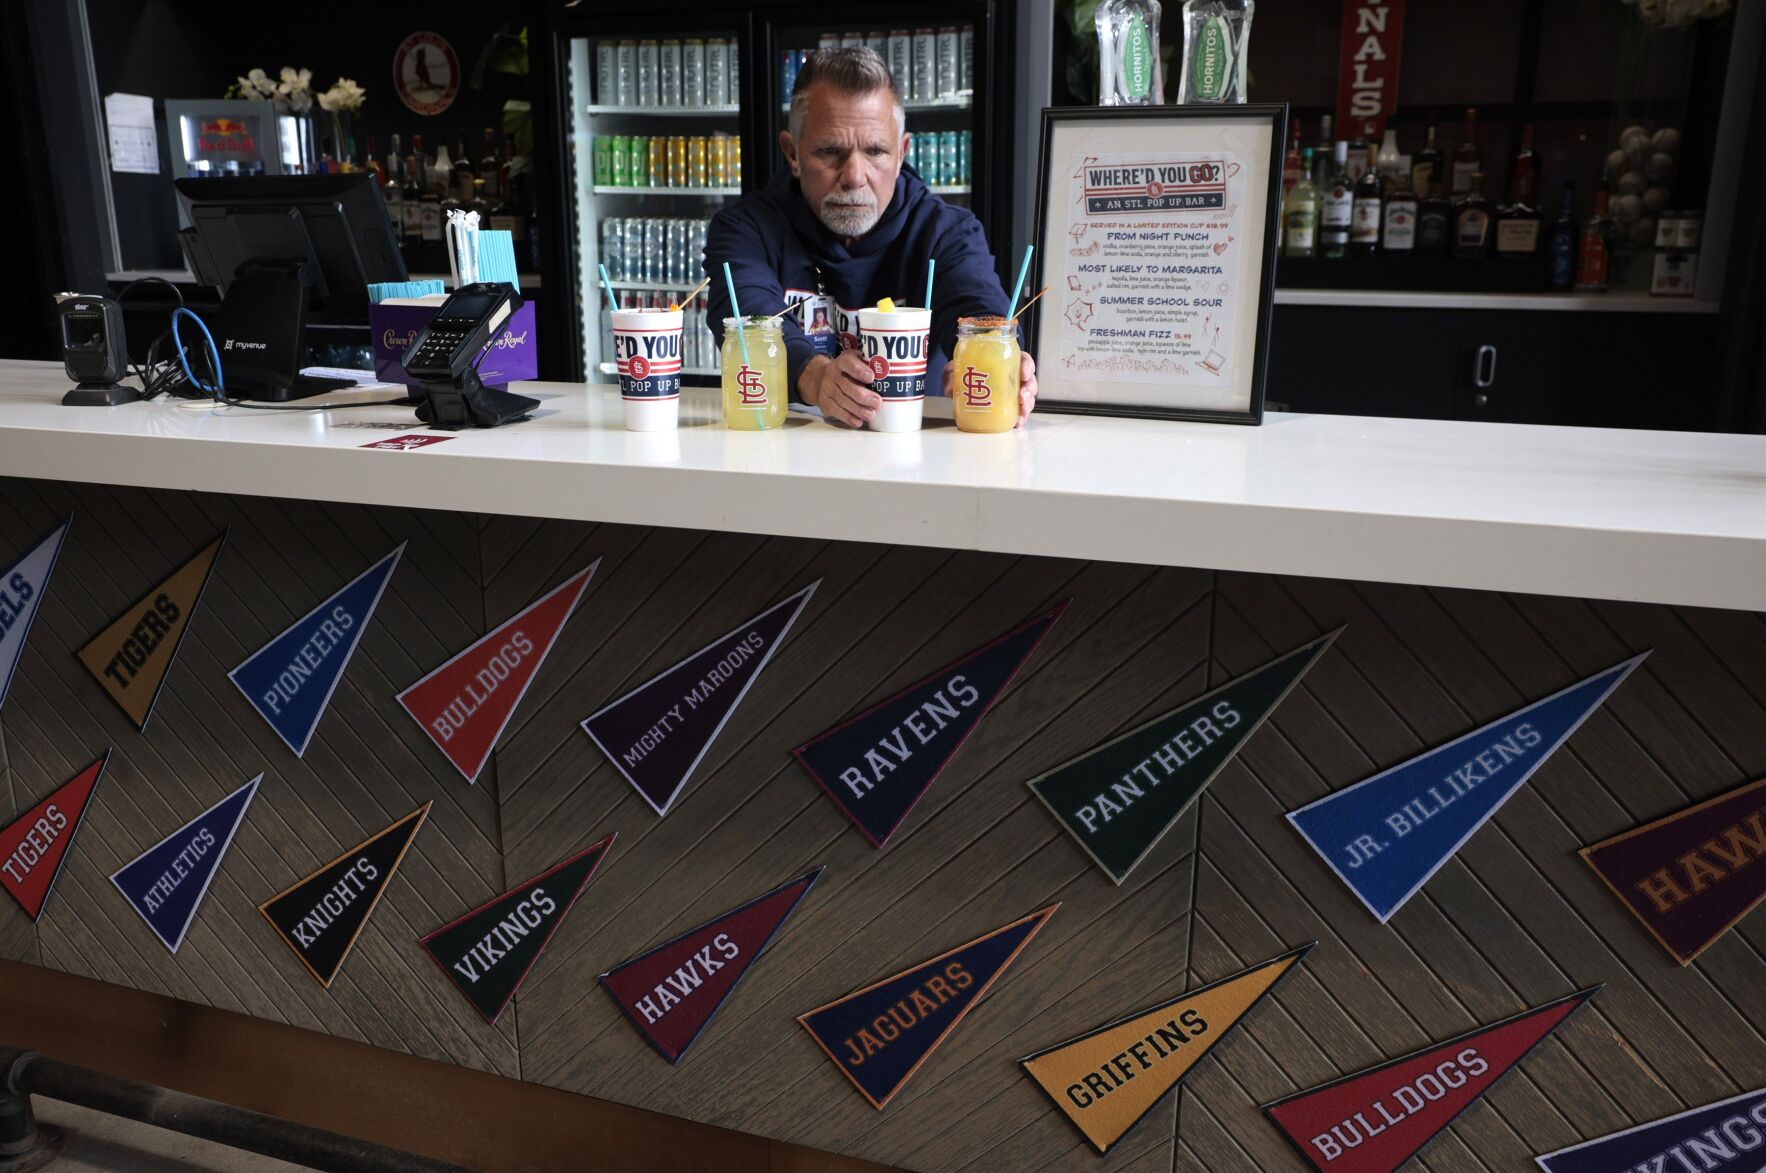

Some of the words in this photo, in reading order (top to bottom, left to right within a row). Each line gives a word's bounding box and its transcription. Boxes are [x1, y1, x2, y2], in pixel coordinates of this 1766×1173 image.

[1133, 28, 1143, 93] HORNITOS
[1203, 28, 1217, 94] HORNITOS
[1090, 167, 1155, 187] WHERE'D
[1158, 165, 1187, 184] YOU
[1189, 164, 1220, 184] GO?
[1107, 200, 1121, 209] AN
[1124, 199, 1143, 208] STL
[1147, 198, 1164, 207] POP
[1169, 198, 1182, 206] UP
[1186, 196, 1205, 206] BAR
[1078, 264, 1106, 273] MOST
[1110, 265, 1142, 273] LIKELY
[1146, 266, 1159, 274] TO
[1162, 266, 1223, 274] MARGARITA
[1174, 232, 1209, 240] PUNCH
[384, 329, 408, 350] Crown
[499, 331, 527, 349] Royal
[1090, 328, 1146, 338] FRESHMAN
[1148, 330, 1172, 338] FIZZ
[1100, 296, 1144, 306] SUMMER
[1146, 298, 1190, 306] SCHOOL
[1192, 298, 1223, 308] SOUR
[630, 381, 651, 392] POP
[658, 380, 672, 392] UP
[642, 335, 678, 360] YOU
[872, 381, 890, 392] POP
[896, 381, 912, 392] UP
[882, 335, 922, 360] YOU
[104, 592, 182, 690] TIGERS
[263, 605, 354, 716] PIONEERS
[432, 630, 534, 742] BULLDOGS
[622, 704, 685, 768] MIGHTY
[684, 631, 764, 712] MAROONS
[839, 674, 980, 800] RAVENS
[1075, 700, 1242, 834] PANTHERS
[1343, 833, 1390, 870] JR.
[1385, 722, 1544, 839] BILLIKENS
[1, 803, 68, 886] TIGERS
[142, 827, 216, 915] ATHLETICS
[291, 857, 379, 950] KNIGHTS
[453, 887, 556, 984] VIKINGS
[634, 932, 741, 1024] HAWKS
[843, 961, 976, 1067] JAGUARS
[1065, 1007, 1210, 1110] GRIFFINS
[1309, 1047, 1490, 1162] BULLDOGS
